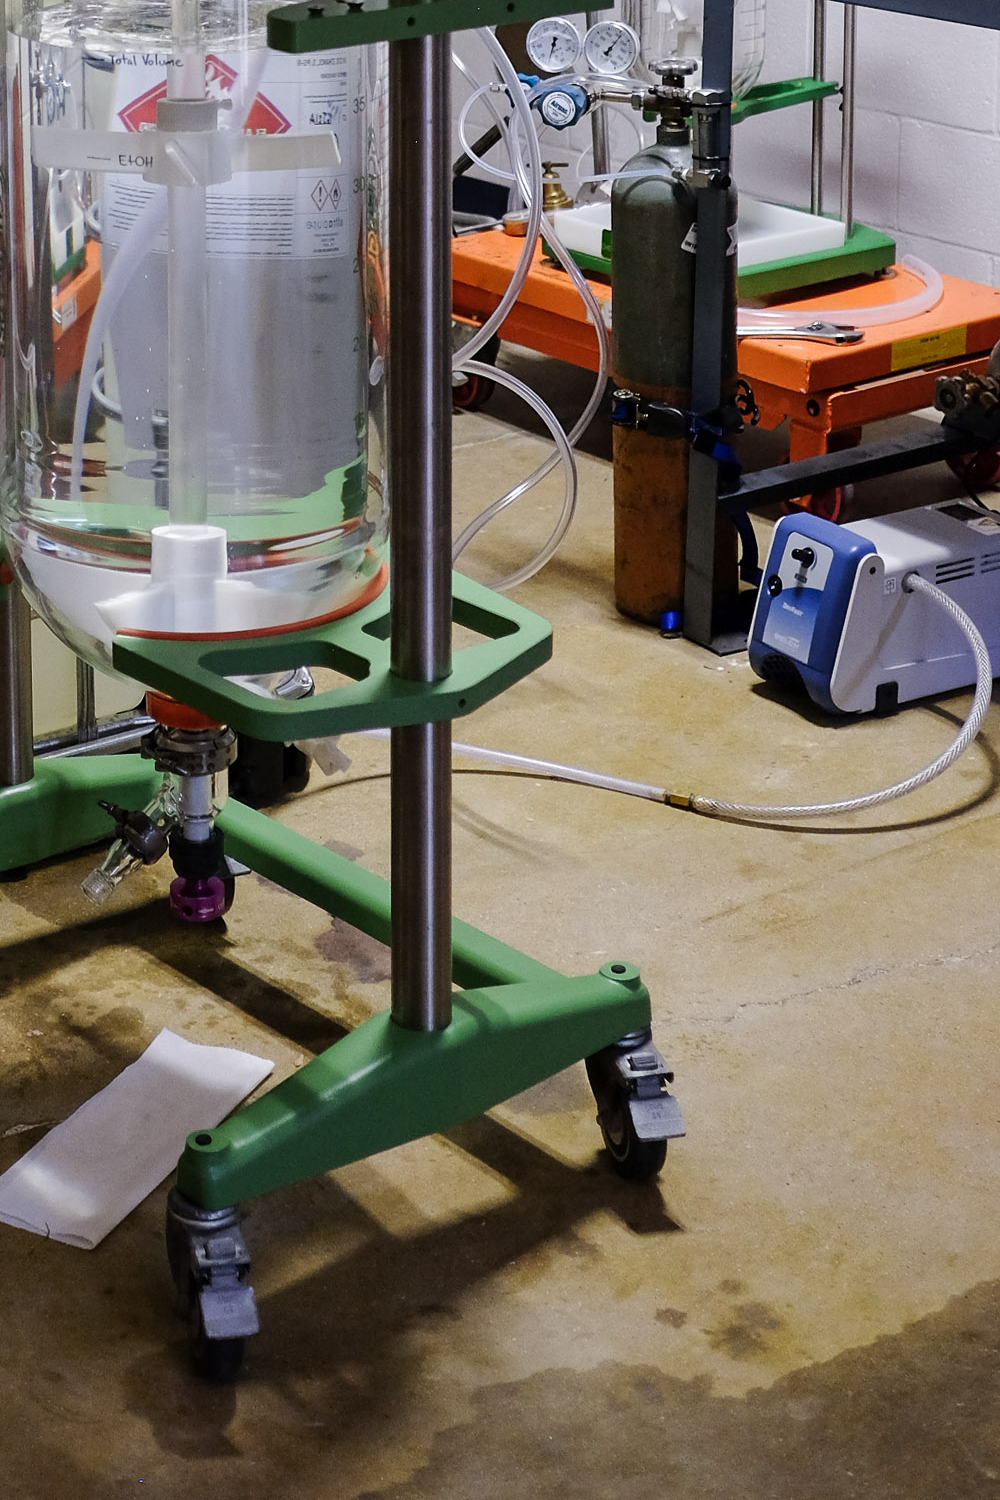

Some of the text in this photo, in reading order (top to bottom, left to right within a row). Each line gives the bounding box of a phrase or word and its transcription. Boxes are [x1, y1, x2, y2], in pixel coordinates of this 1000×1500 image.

[108, 53, 185, 68] Total Volume
[353, 96, 366, 114] 35
